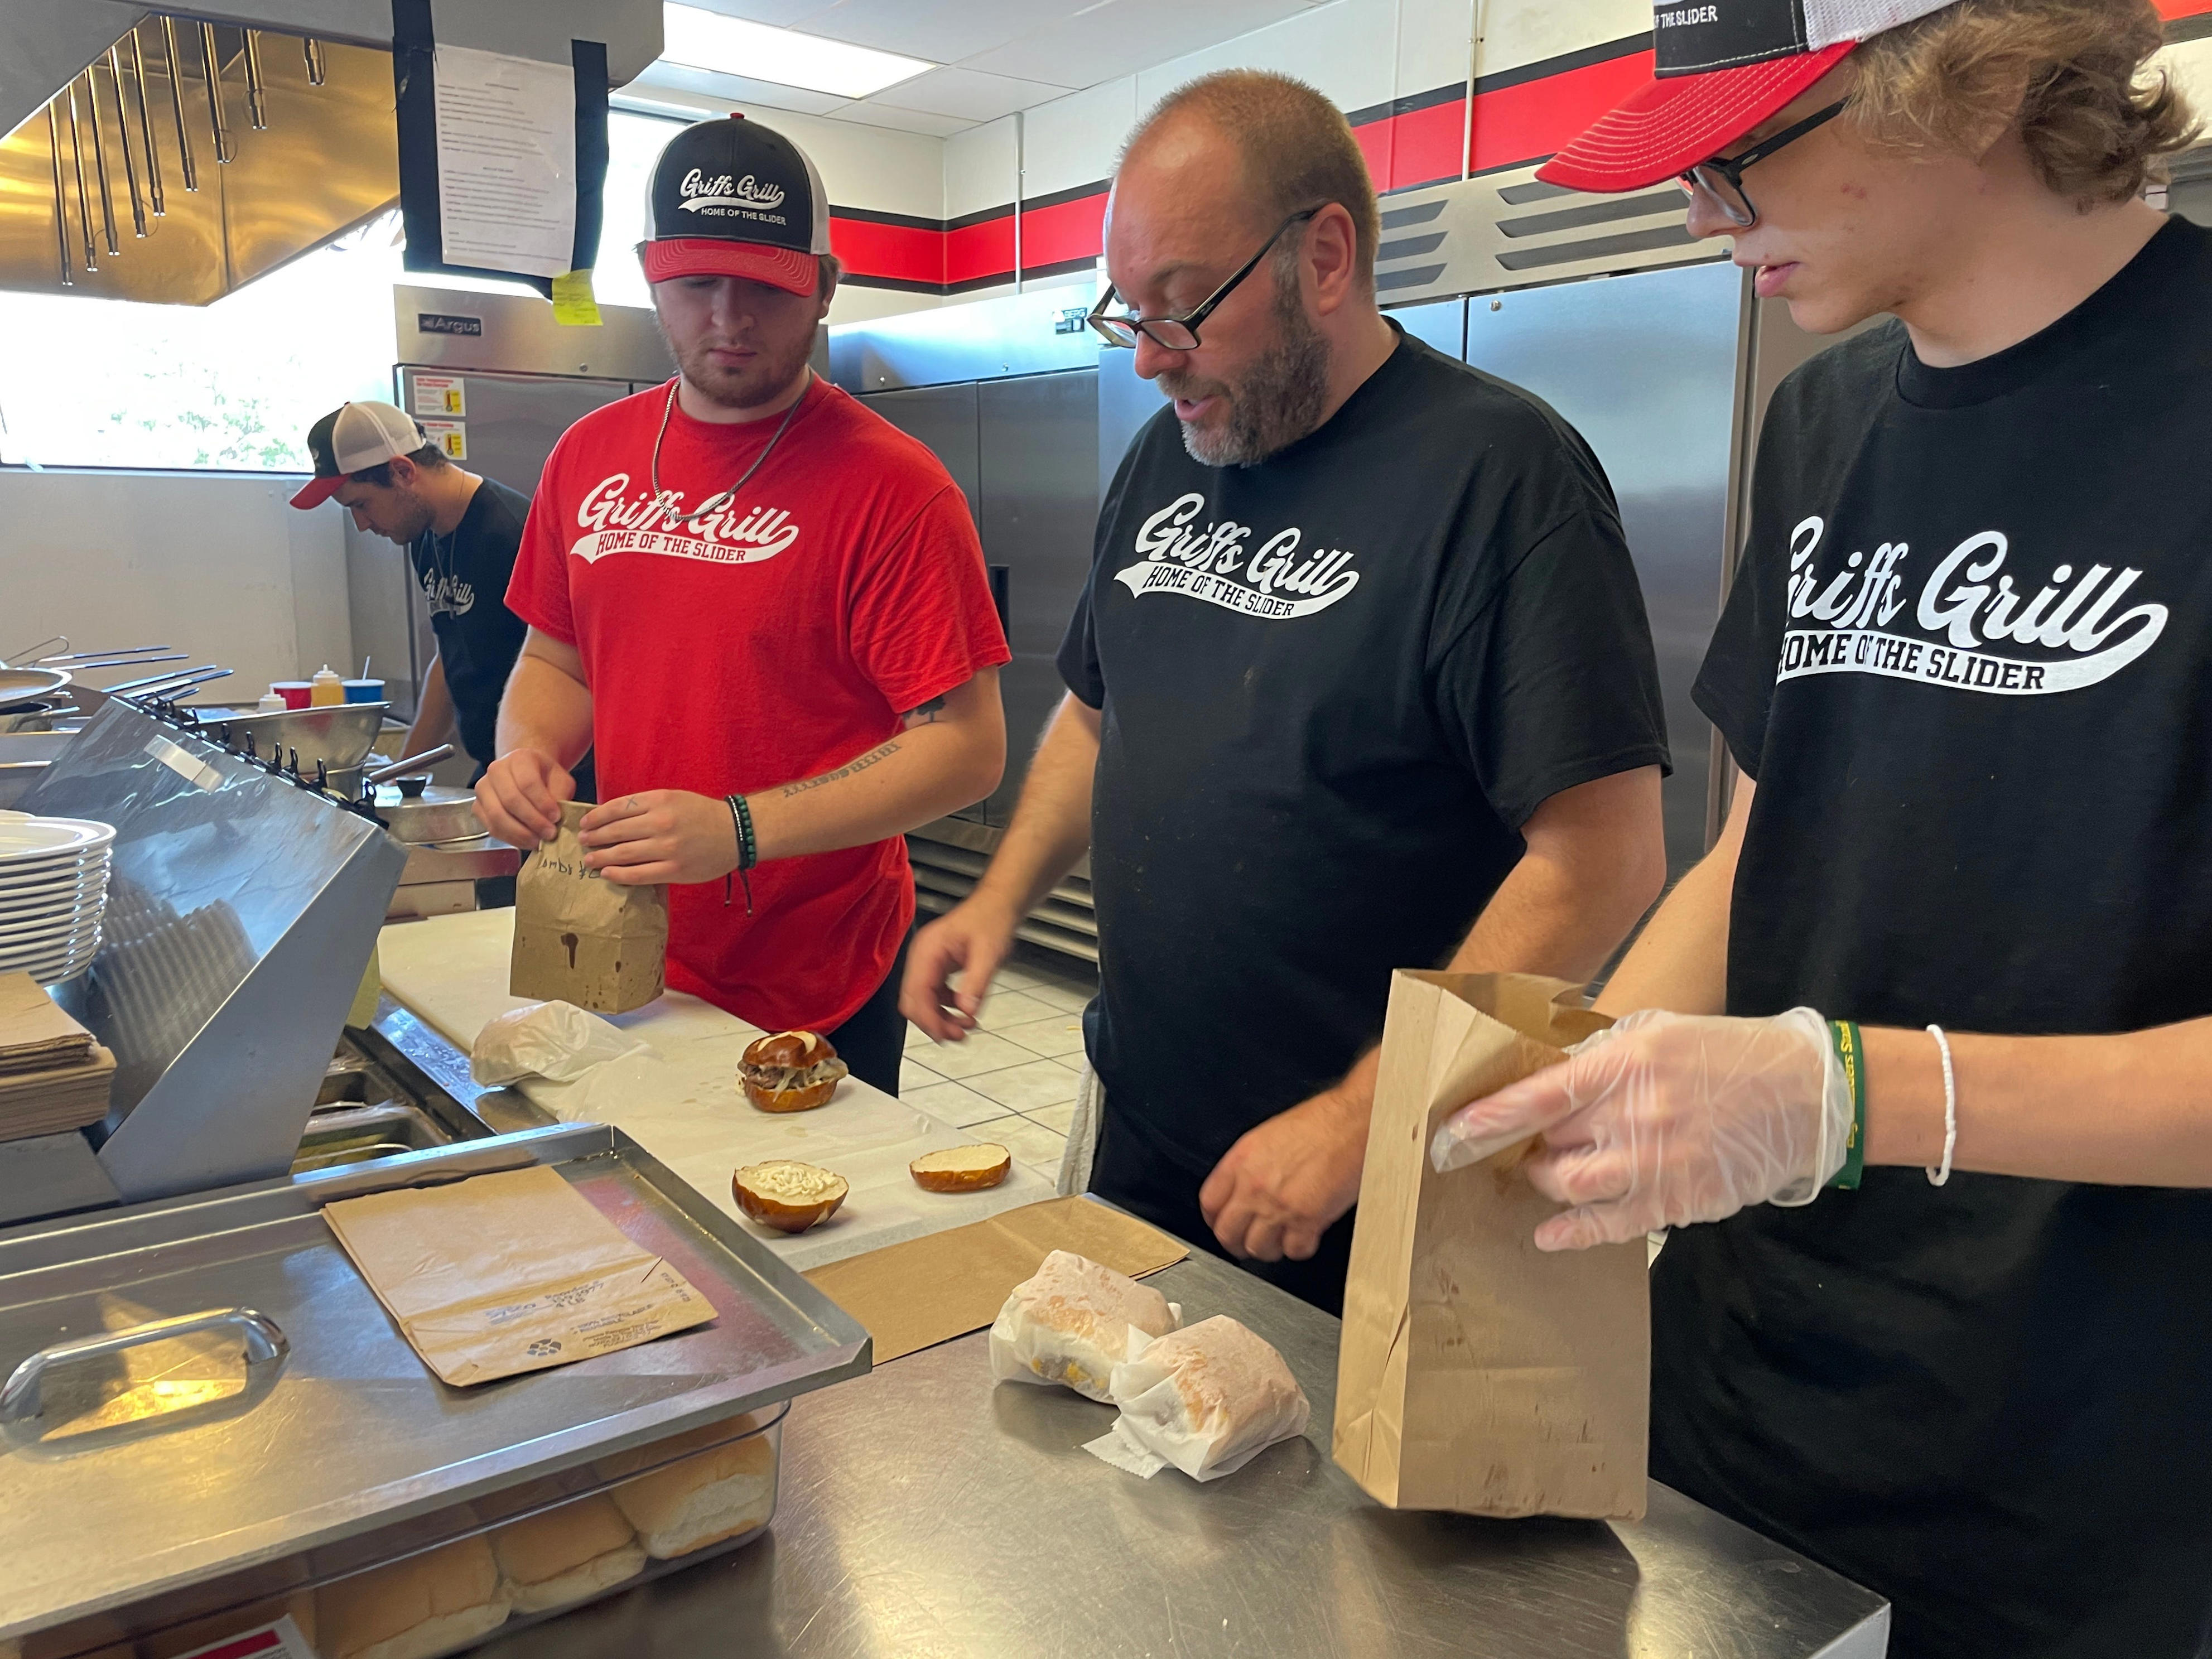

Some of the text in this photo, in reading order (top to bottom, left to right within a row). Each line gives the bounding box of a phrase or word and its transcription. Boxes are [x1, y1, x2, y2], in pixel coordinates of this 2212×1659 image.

[1660, 12, 1675, 28] THE
[1676, 5, 1718, 26] SLIDER
[737, 175, 785, 201] Grill
[701, 208, 725, 216] HOME
[727, 209, 740, 217] OF
[741, 211, 758, 220] THE
[435, 317, 480, 334] Argus
[688, 491, 799, 544] Grill
[595, 532, 746, 561] HOME OF THE SLIDER
[1246, 527, 1360, 596] Grill
[1141, 565, 1295, 616] HOME OF THE SLIDER
[1917, 531, 2168, 652] Grill
[1777, 634, 2045, 690] OME O THE SLIDER
